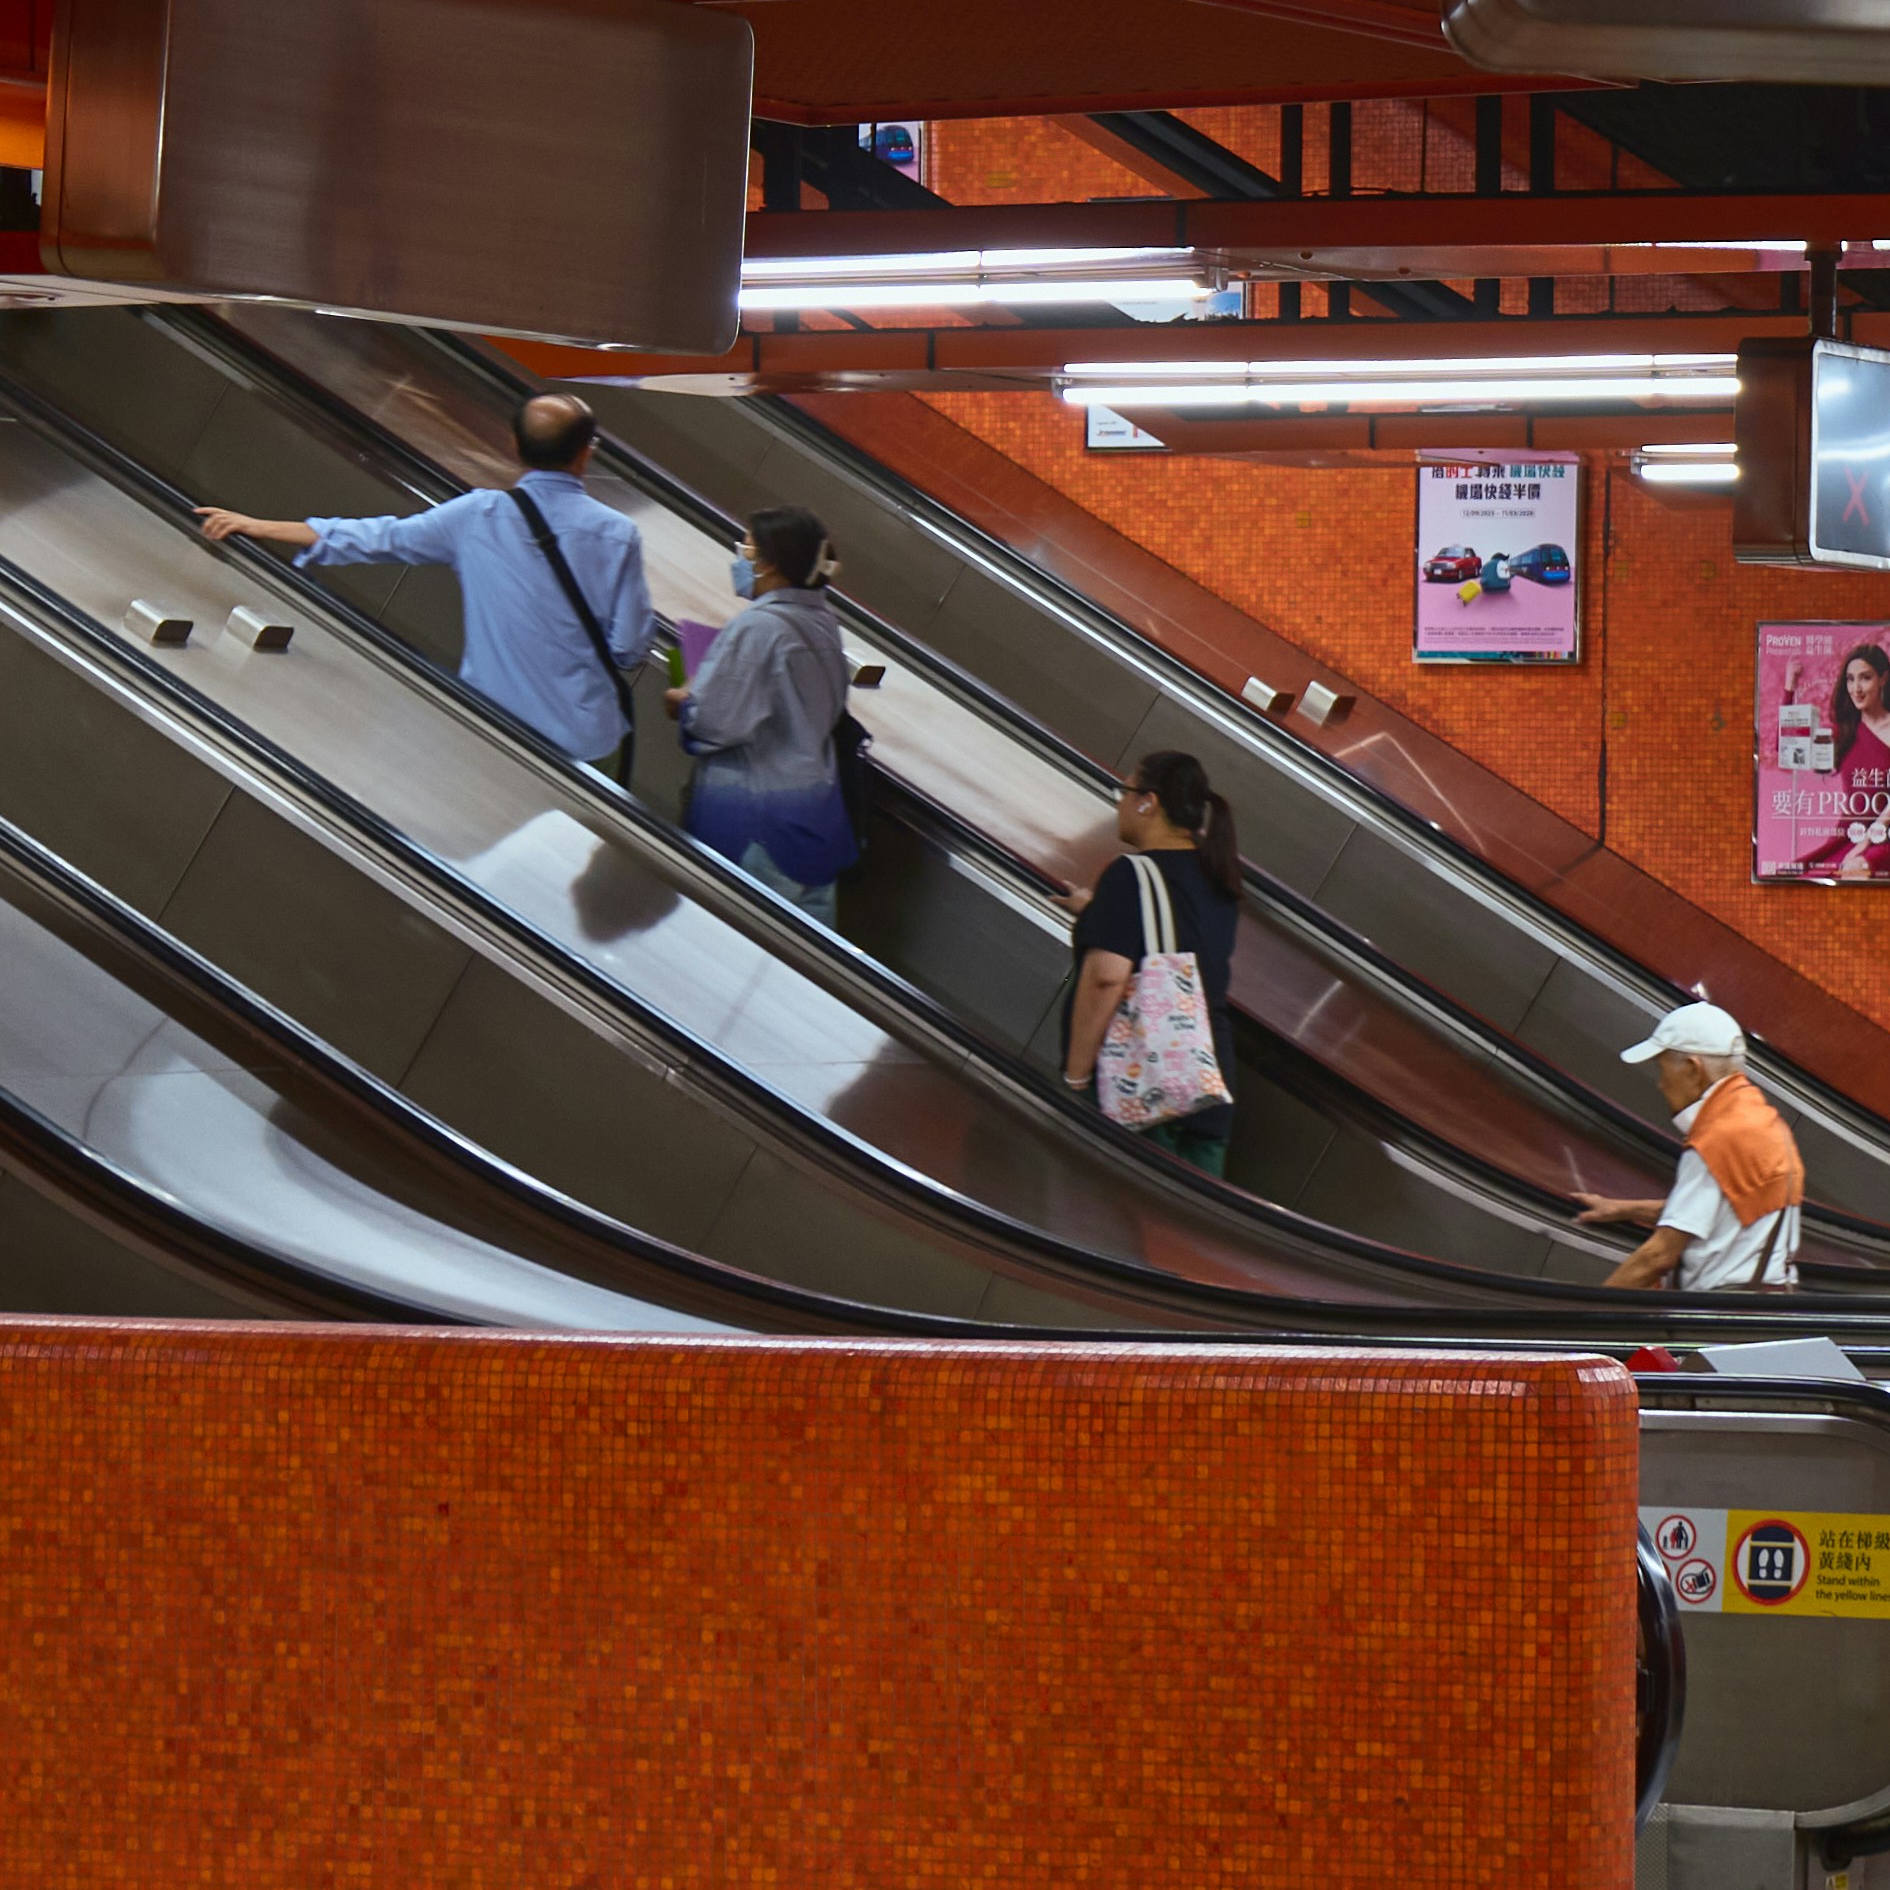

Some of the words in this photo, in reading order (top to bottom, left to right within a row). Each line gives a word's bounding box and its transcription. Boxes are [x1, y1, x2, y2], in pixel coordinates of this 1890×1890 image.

[1819, 1530, 1890, 1550] 站在梯級
[1816, 1574, 1845, 1586] Stand
[1847, 1576, 1881, 1587] within
[1816, 1589, 1834, 1600] the
[1834, 1590, 1868, 1603] yellow
